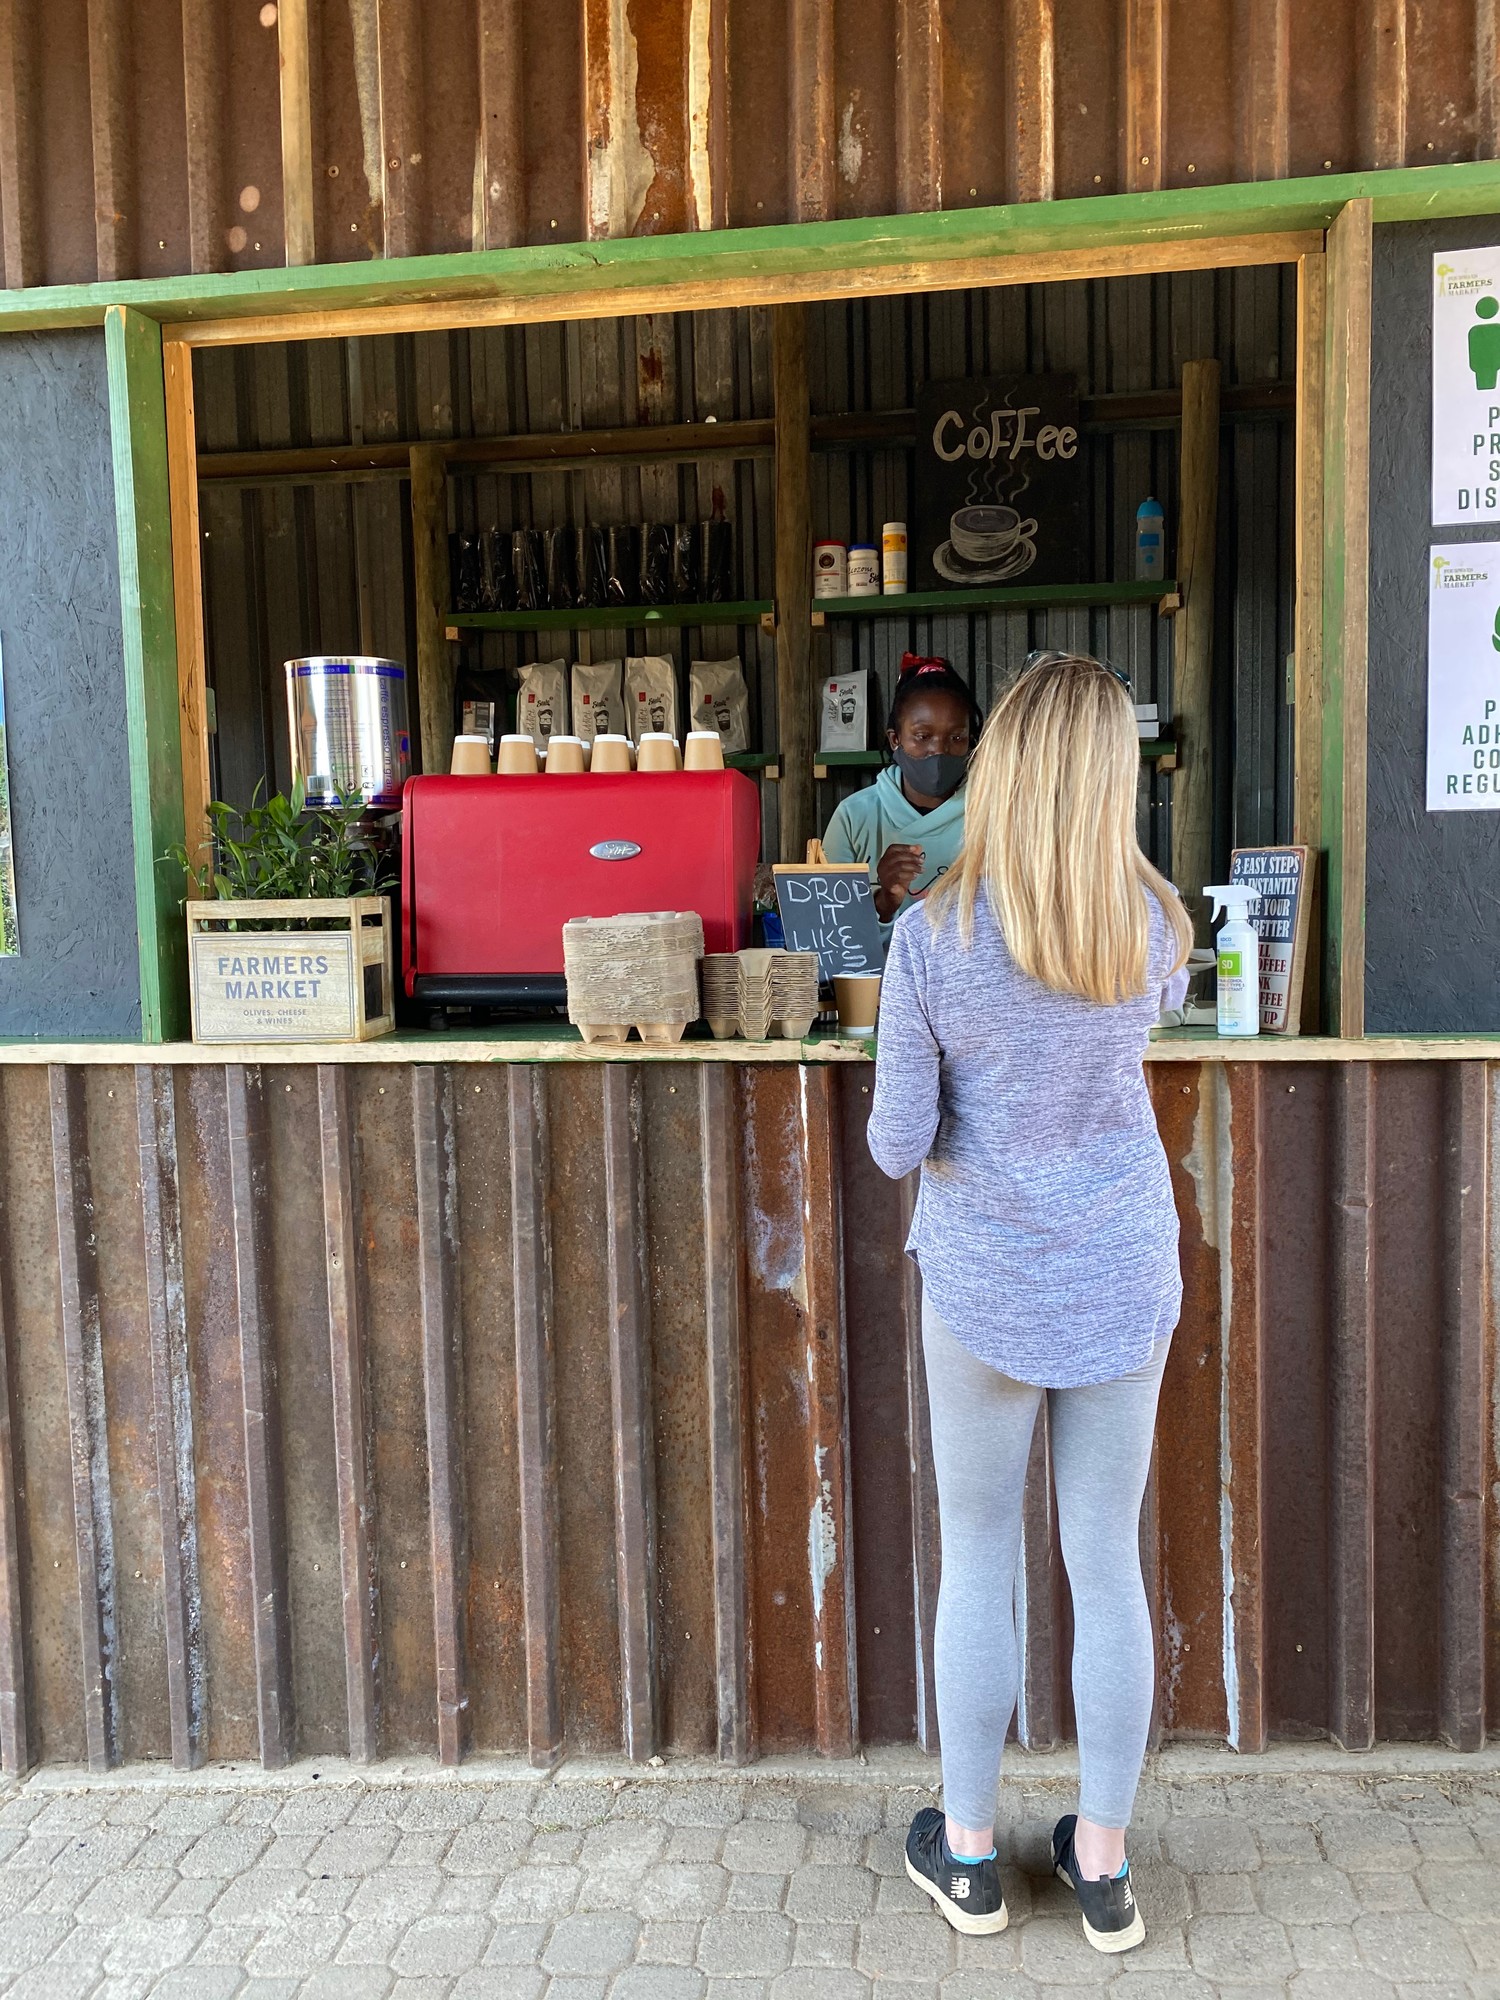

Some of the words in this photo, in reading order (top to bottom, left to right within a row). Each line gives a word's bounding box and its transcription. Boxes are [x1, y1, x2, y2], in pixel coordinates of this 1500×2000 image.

[1448, 279, 1493, 290] FARMERS
[1443, 573, 1488, 582] FARMERS
[381, 705, 392, 756] espresso
[1234, 857, 1242, 875] 3
[1242, 856, 1268, 875] EASY
[1269, 855, 1300, 874] STEPS
[786, 877, 872, 905] DROP
[819, 904, 845, 926] IT
[1263, 898, 1291, 917] YOUR
[793, 925, 863, 952] LIKE
[218, 955, 329, 976] FARMERS
[818, 950, 868, 968] IT'S
[1221, 959, 1233, 970] SD
[1258, 958, 1287, 973] OFFEE
[225, 980, 321, 999] MARKET
[265, 1017, 293, 1025] WINES
[277, 1008, 307, 1017] CHEESE
[1264, 1010, 1279, 1025] UP
